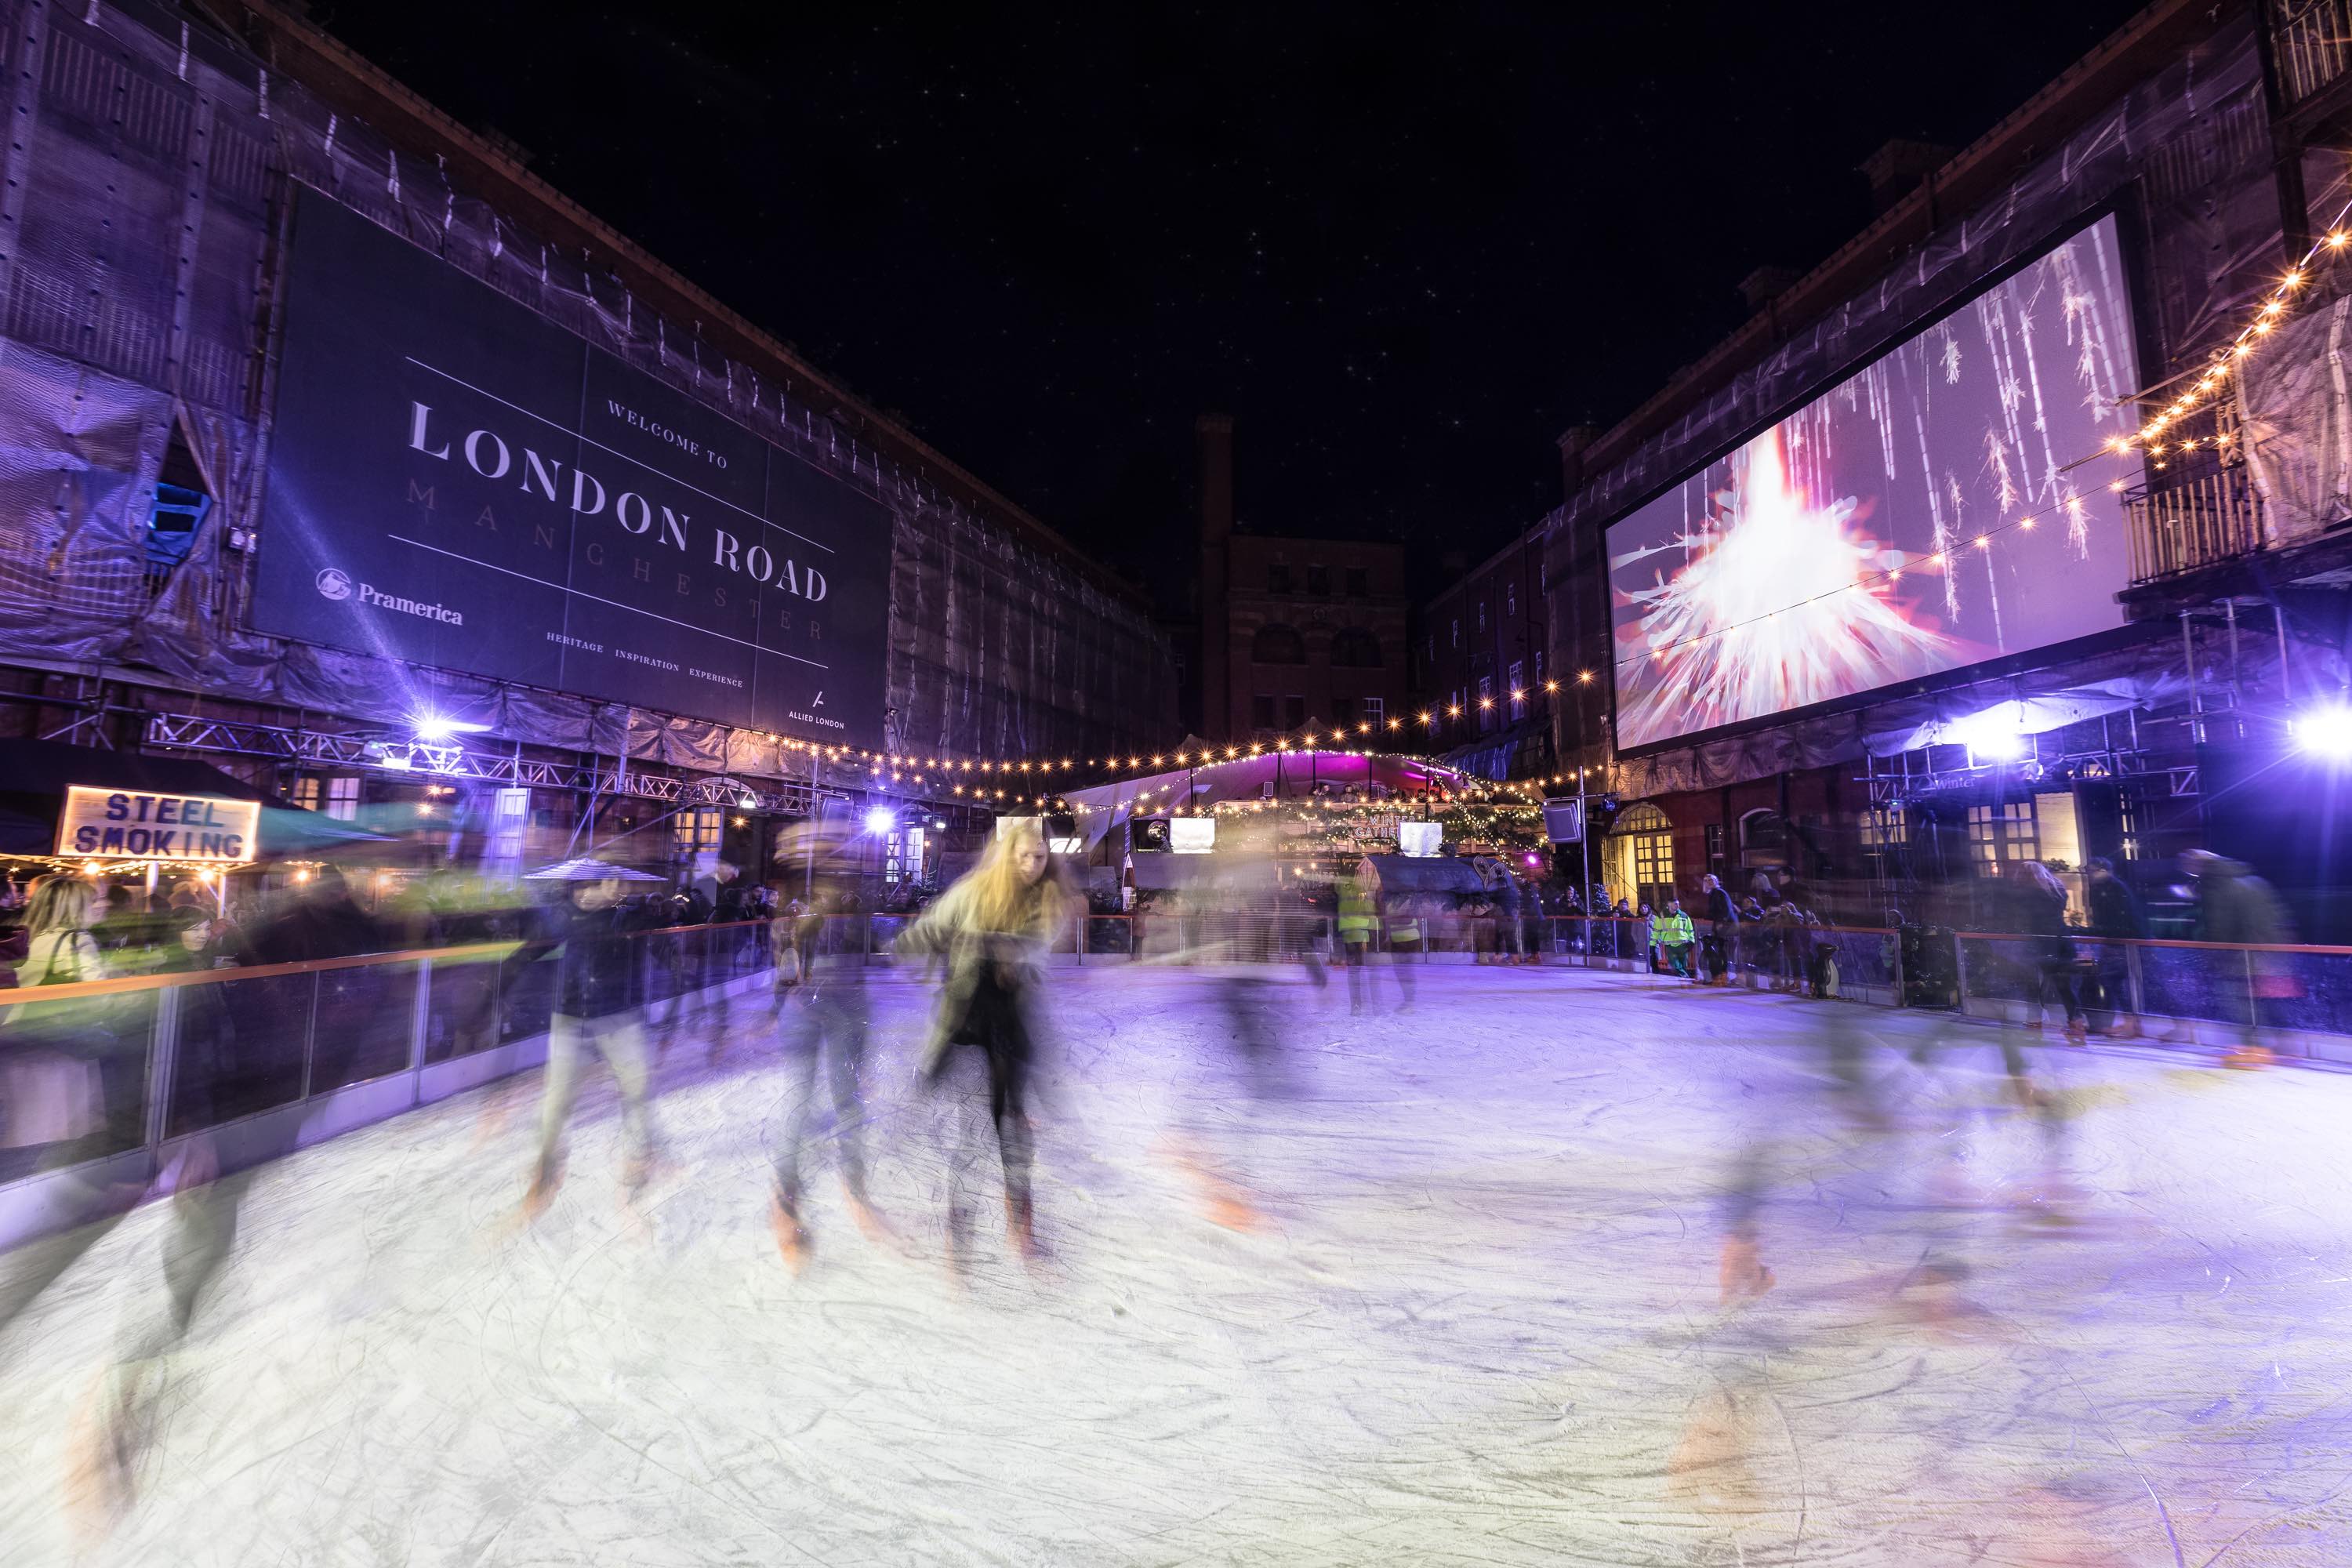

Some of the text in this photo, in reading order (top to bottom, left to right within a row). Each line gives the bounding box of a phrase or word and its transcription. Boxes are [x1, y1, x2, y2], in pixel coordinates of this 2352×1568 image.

[608, 400, 728, 469] WELCOME TO
[408, 401, 827, 602] LONDON ROAD
[405, 478, 822, 640] MANCHESTER
[357, 583, 463, 626] Pramerica
[546, 632, 743, 688] HERITAGE INSPIRATION EXPERIENCE
[789, 710, 844, 730] ALLIED LONDON
[106, 793, 225, 828] STEEL
[1355, 826, 1400, 838] GATHE
[74, 826, 243, 858] SMOKING
